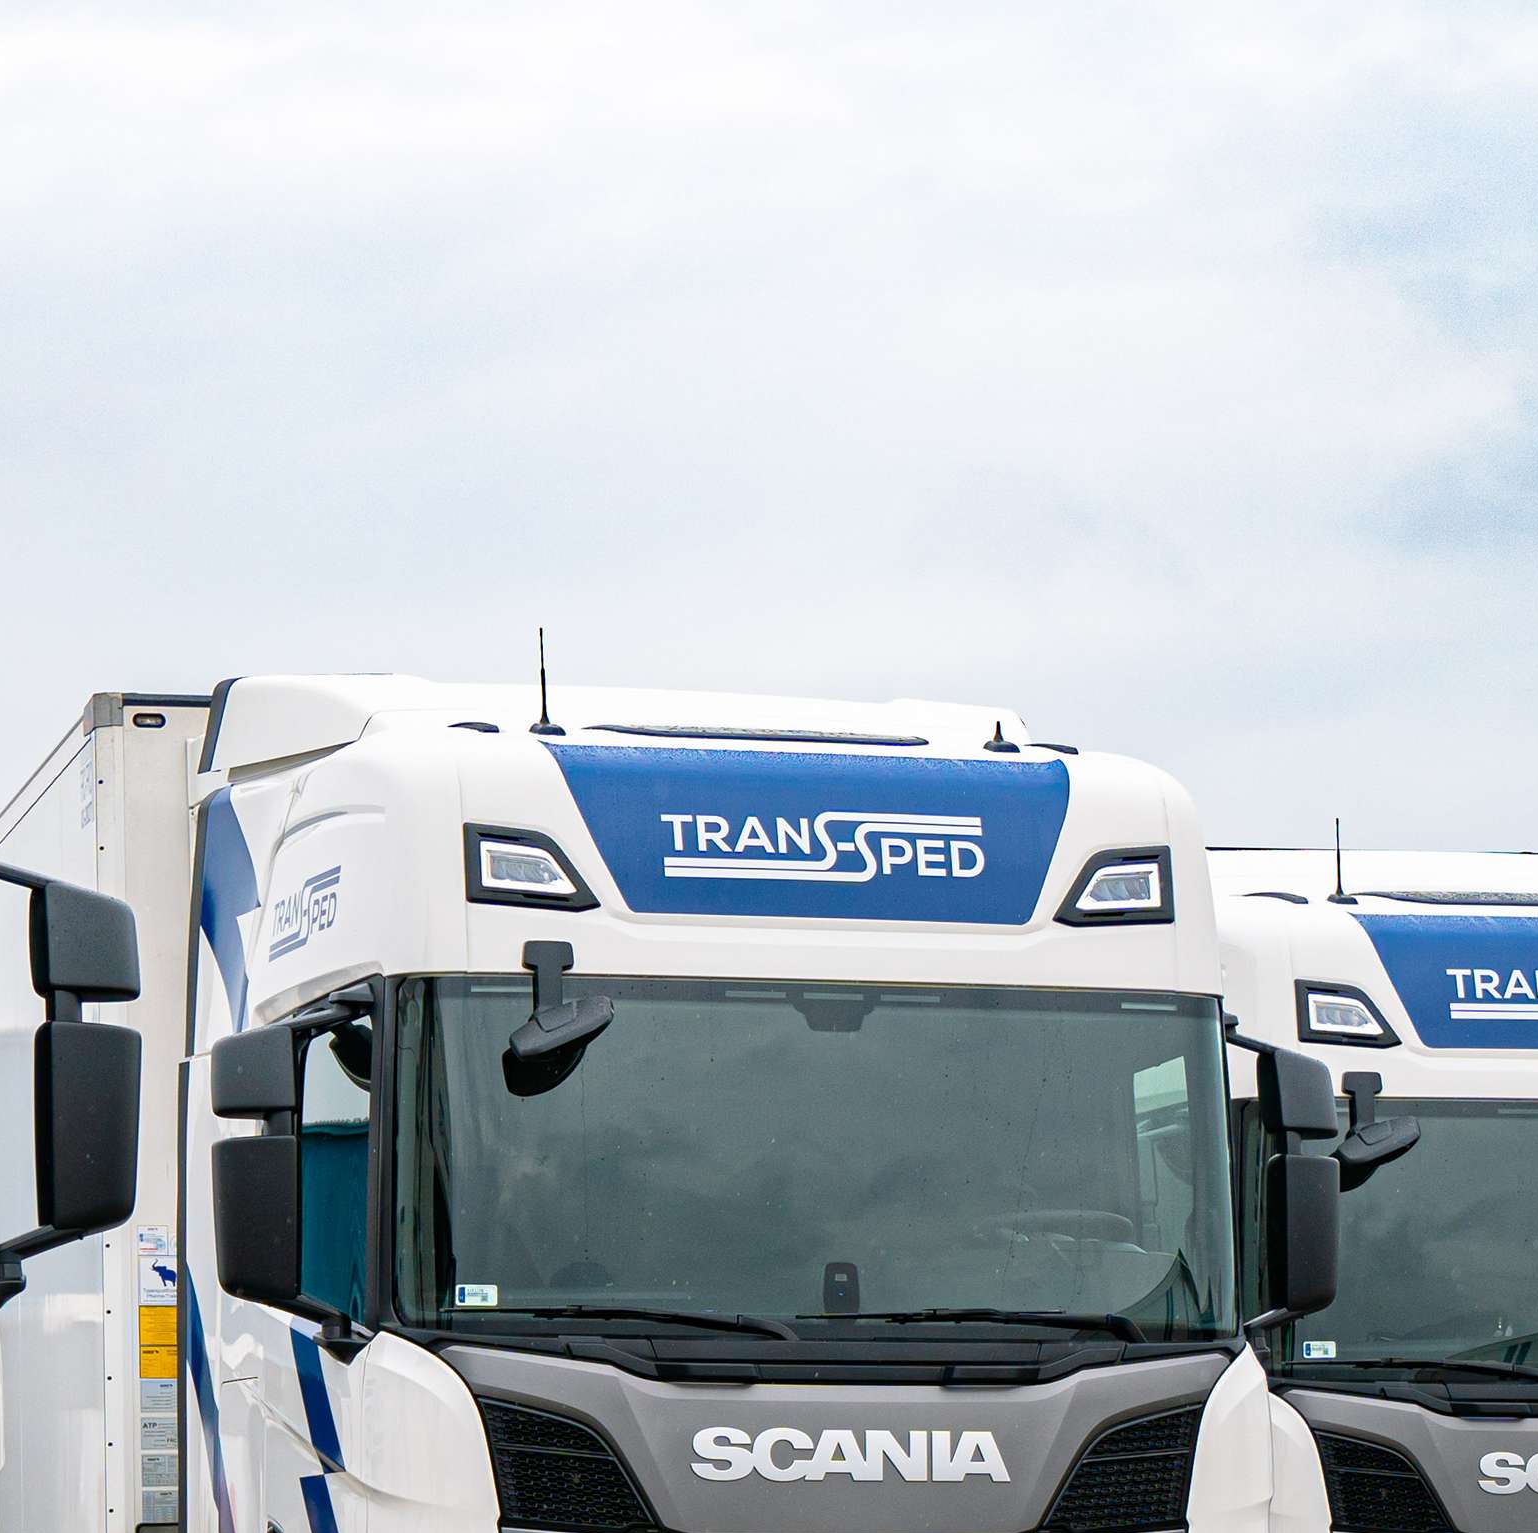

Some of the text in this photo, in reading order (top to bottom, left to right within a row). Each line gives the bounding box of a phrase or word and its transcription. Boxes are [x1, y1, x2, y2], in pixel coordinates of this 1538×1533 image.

[660, 811, 985, 883] TRANS-SPED
[269, 865, 341, 963] TRANS-SPED
[690, 1426, 1011, 1483] SCANIA
